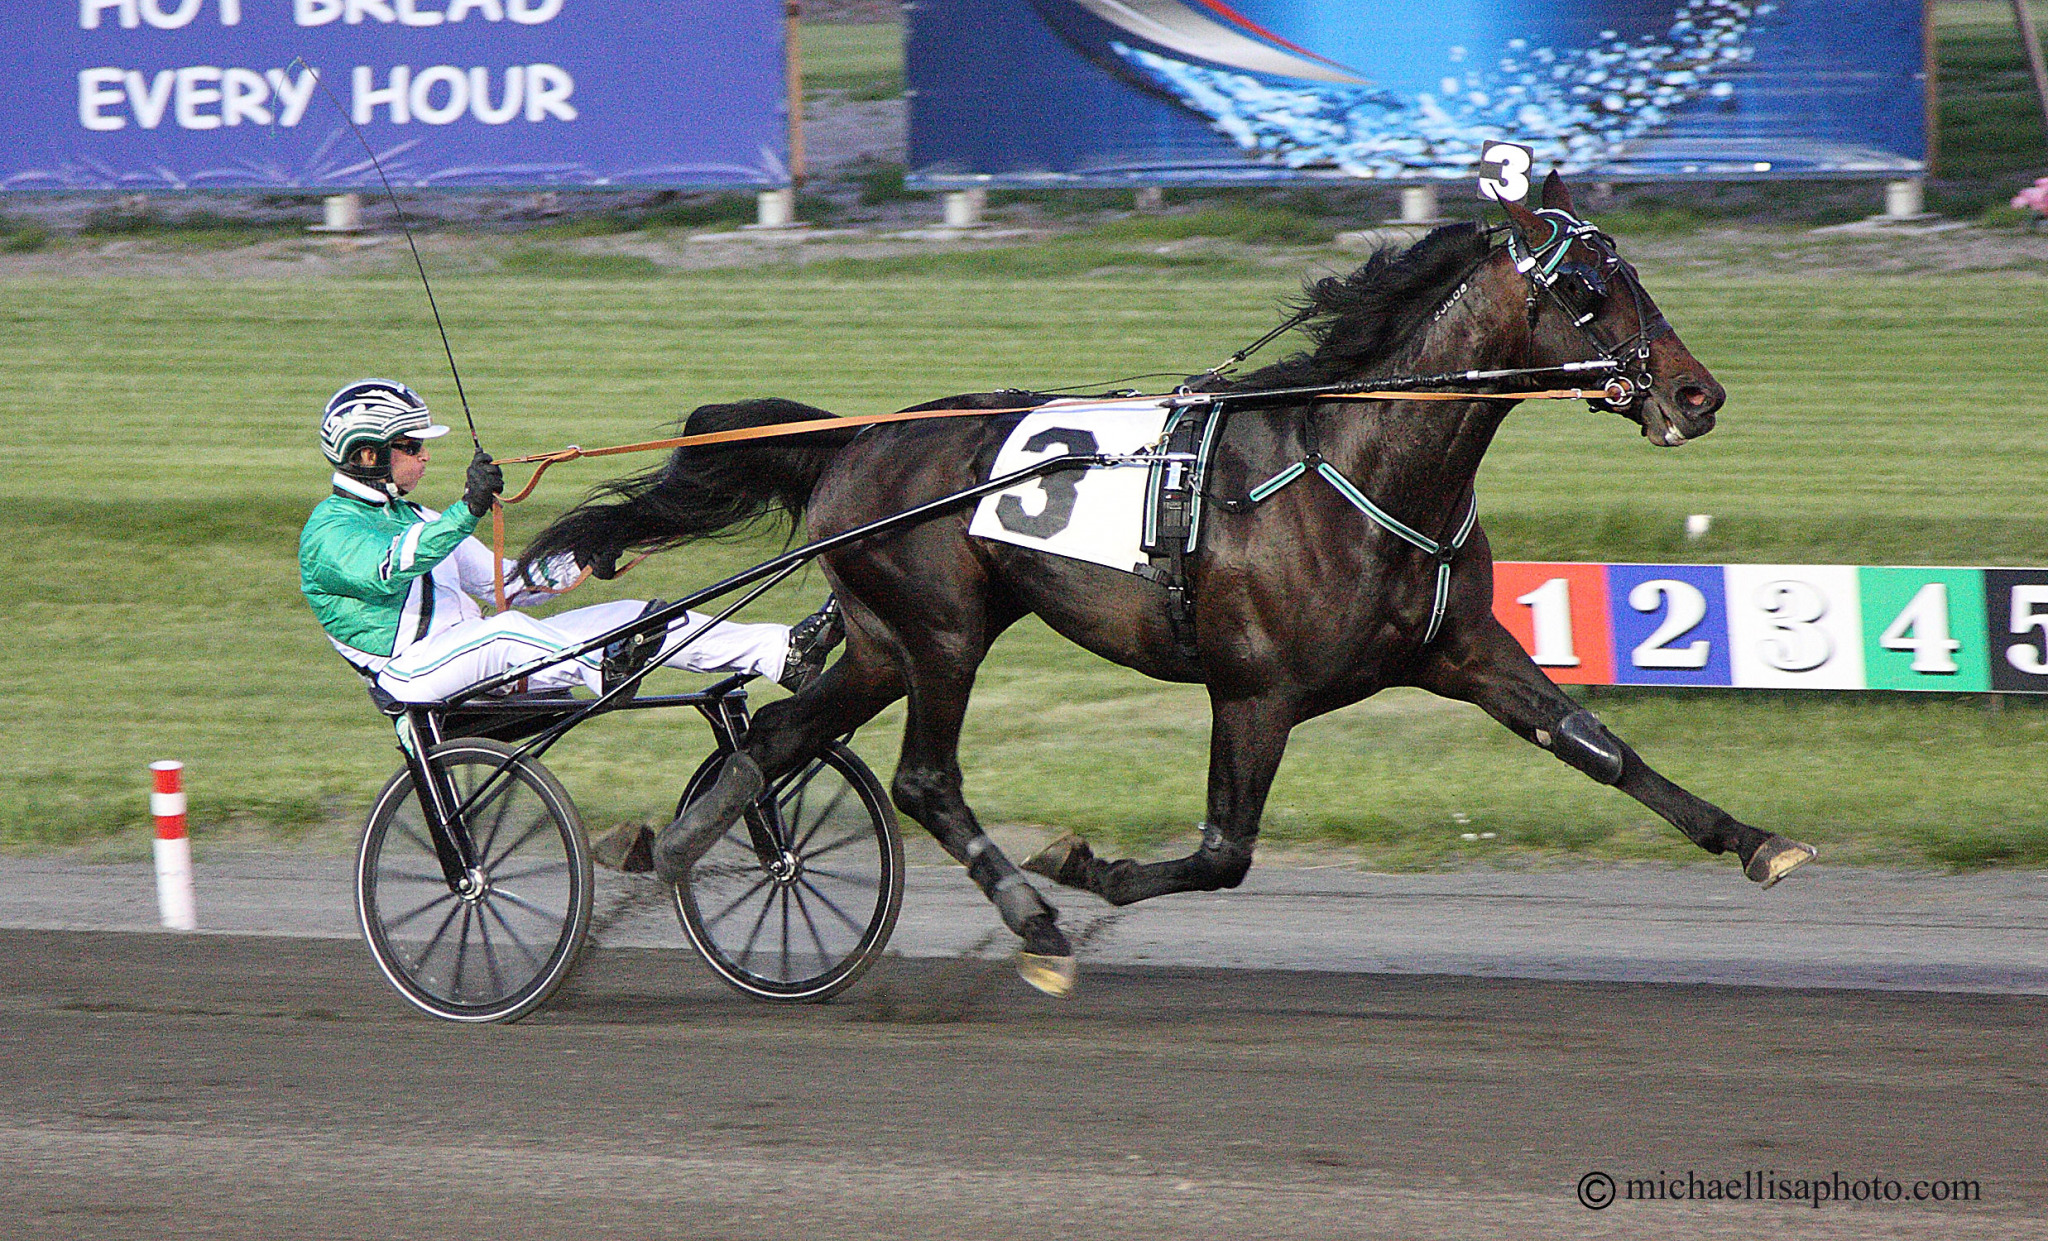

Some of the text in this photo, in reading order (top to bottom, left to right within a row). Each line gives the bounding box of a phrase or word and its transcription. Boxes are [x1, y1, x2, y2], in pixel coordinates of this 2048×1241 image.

[79, 63, 578, 131] EVERY HOUR
[1479, 144, 1530, 201] 3
[995, 426, 1100, 540] 3
[1517, 578, 2048, 675] 1 2 3 4 5
